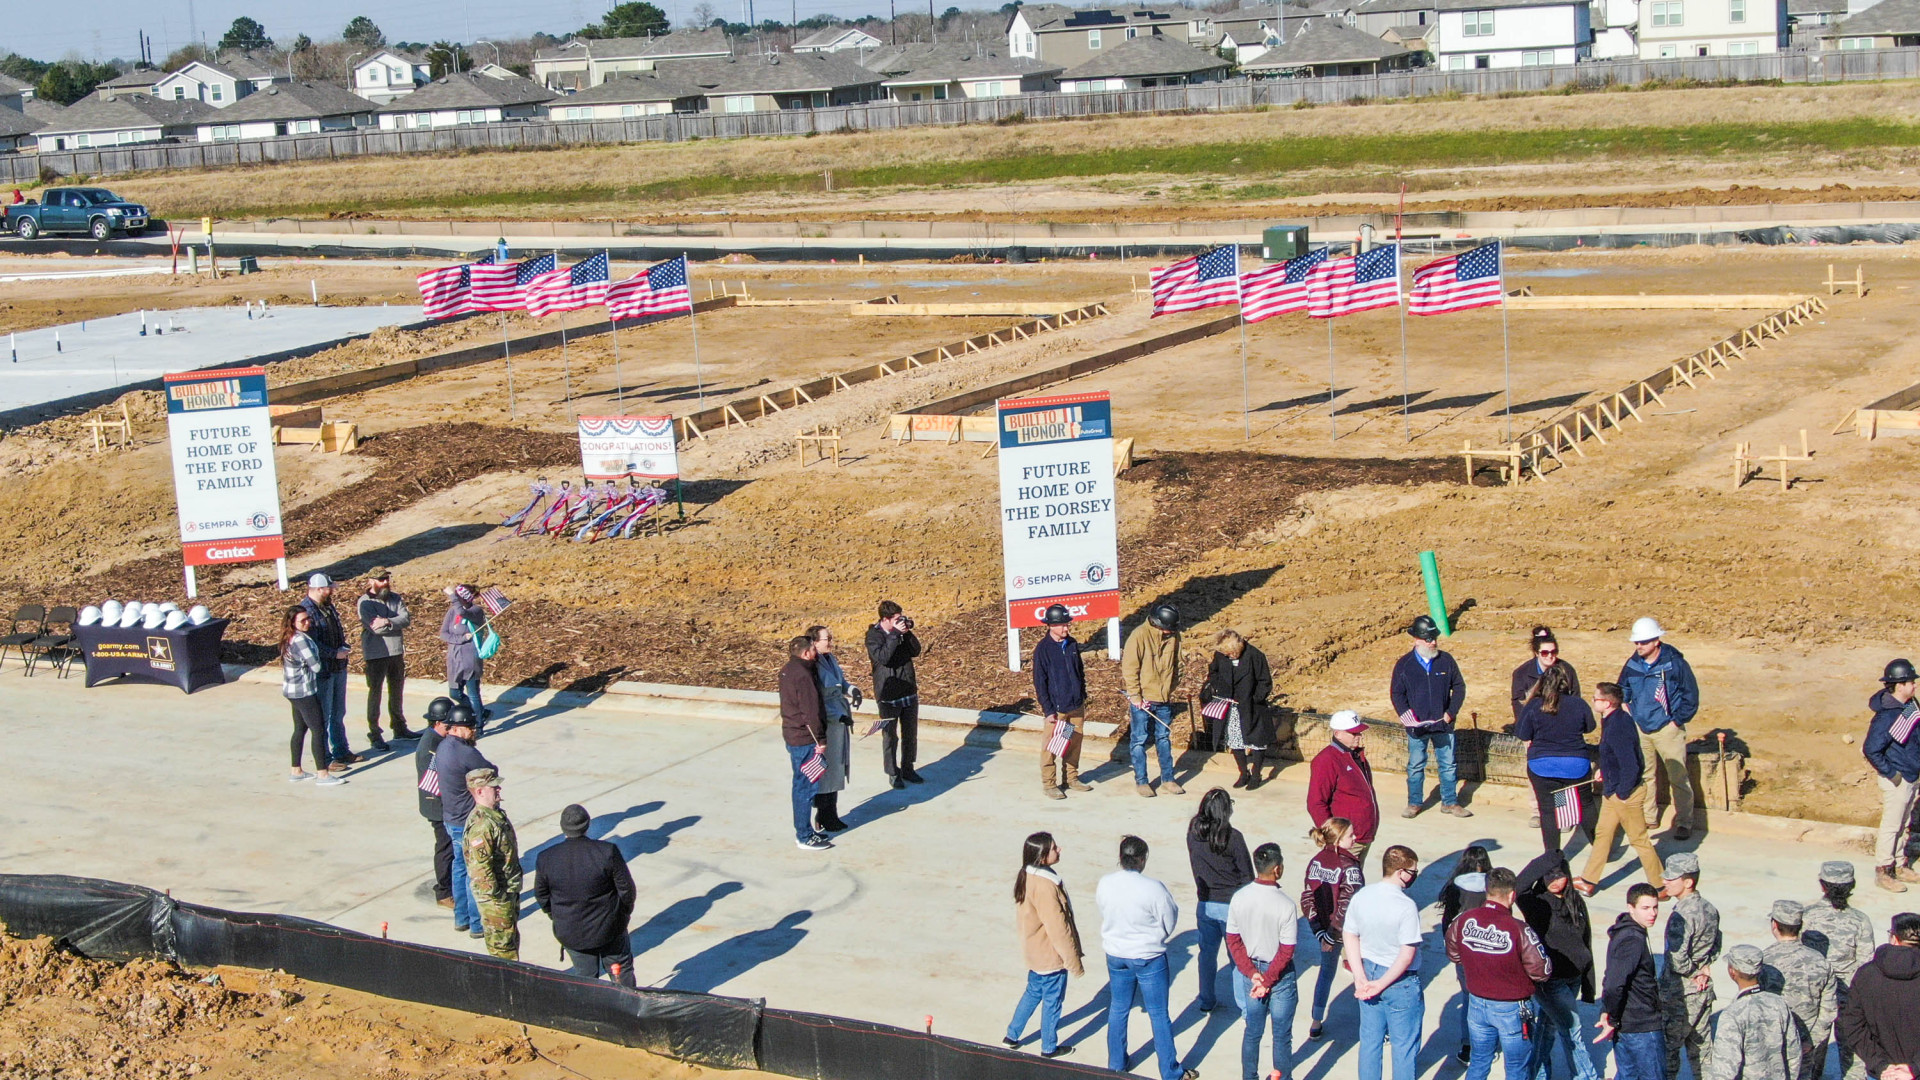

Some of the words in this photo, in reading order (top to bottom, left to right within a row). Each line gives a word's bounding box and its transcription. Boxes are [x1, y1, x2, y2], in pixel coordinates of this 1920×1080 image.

[175, 383, 202, 398] BUILT
[204, 382, 218, 395] TO
[187, 393, 226, 409] HONOR
[1009, 412, 1040, 429] BUILT
[1042, 410, 1057, 424] TO
[189, 425, 252, 441] FUTURE
[1022, 423, 1066, 442] HONOR
[186, 443, 233, 458] HOME
[237, 442, 258, 454] OF
[185, 461, 217, 475] THE
[221, 458, 263, 472] FORD
[1022, 460, 1091, 480] FUTURE
[197, 475, 254, 491] FAMILY
[1018, 482, 1070, 500] HOME
[1075, 480, 1097, 494] OF
[1005, 505, 1040, 521] THE
[1045, 498, 1112, 517] DORSEY
[198, 519, 239, 530] SEMPRA
[1027, 520, 1091, 539] FAMILY
[206, 546, 255, 559] Centex
[1027, 572, 1072, 586] SEMPRA
[1034, 603, 1088, 620] Ctex
[91, 651, 149, 659] 1-800-USA-ARMY
[1462, 919, 1509, 944] Sanders
